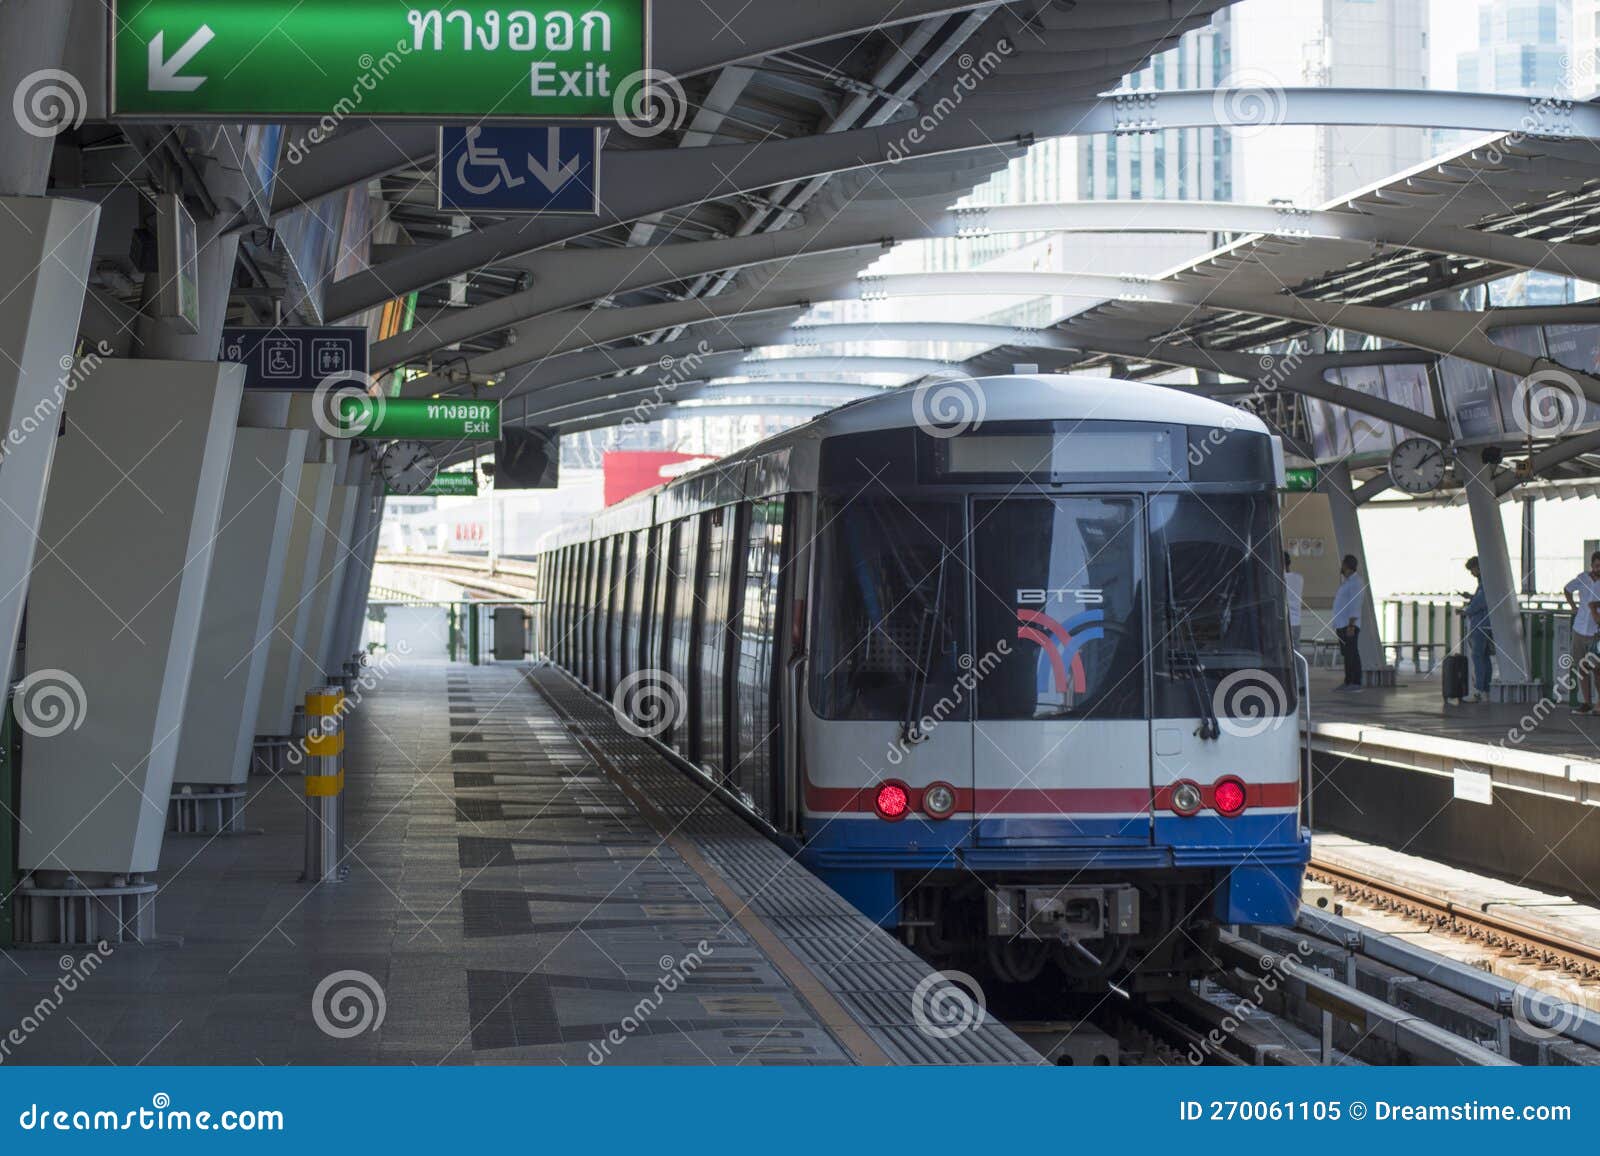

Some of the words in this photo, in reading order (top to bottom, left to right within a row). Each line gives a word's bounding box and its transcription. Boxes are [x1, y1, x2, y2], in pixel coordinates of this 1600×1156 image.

[407, 9, 611, 51] ทางออก
[531, 62, 611, 97] Exit
[427, 405, 491, 419] ทางออก
[464, 421, 490, 433] Exit
[1017, 588, 1103, 603] BTS
